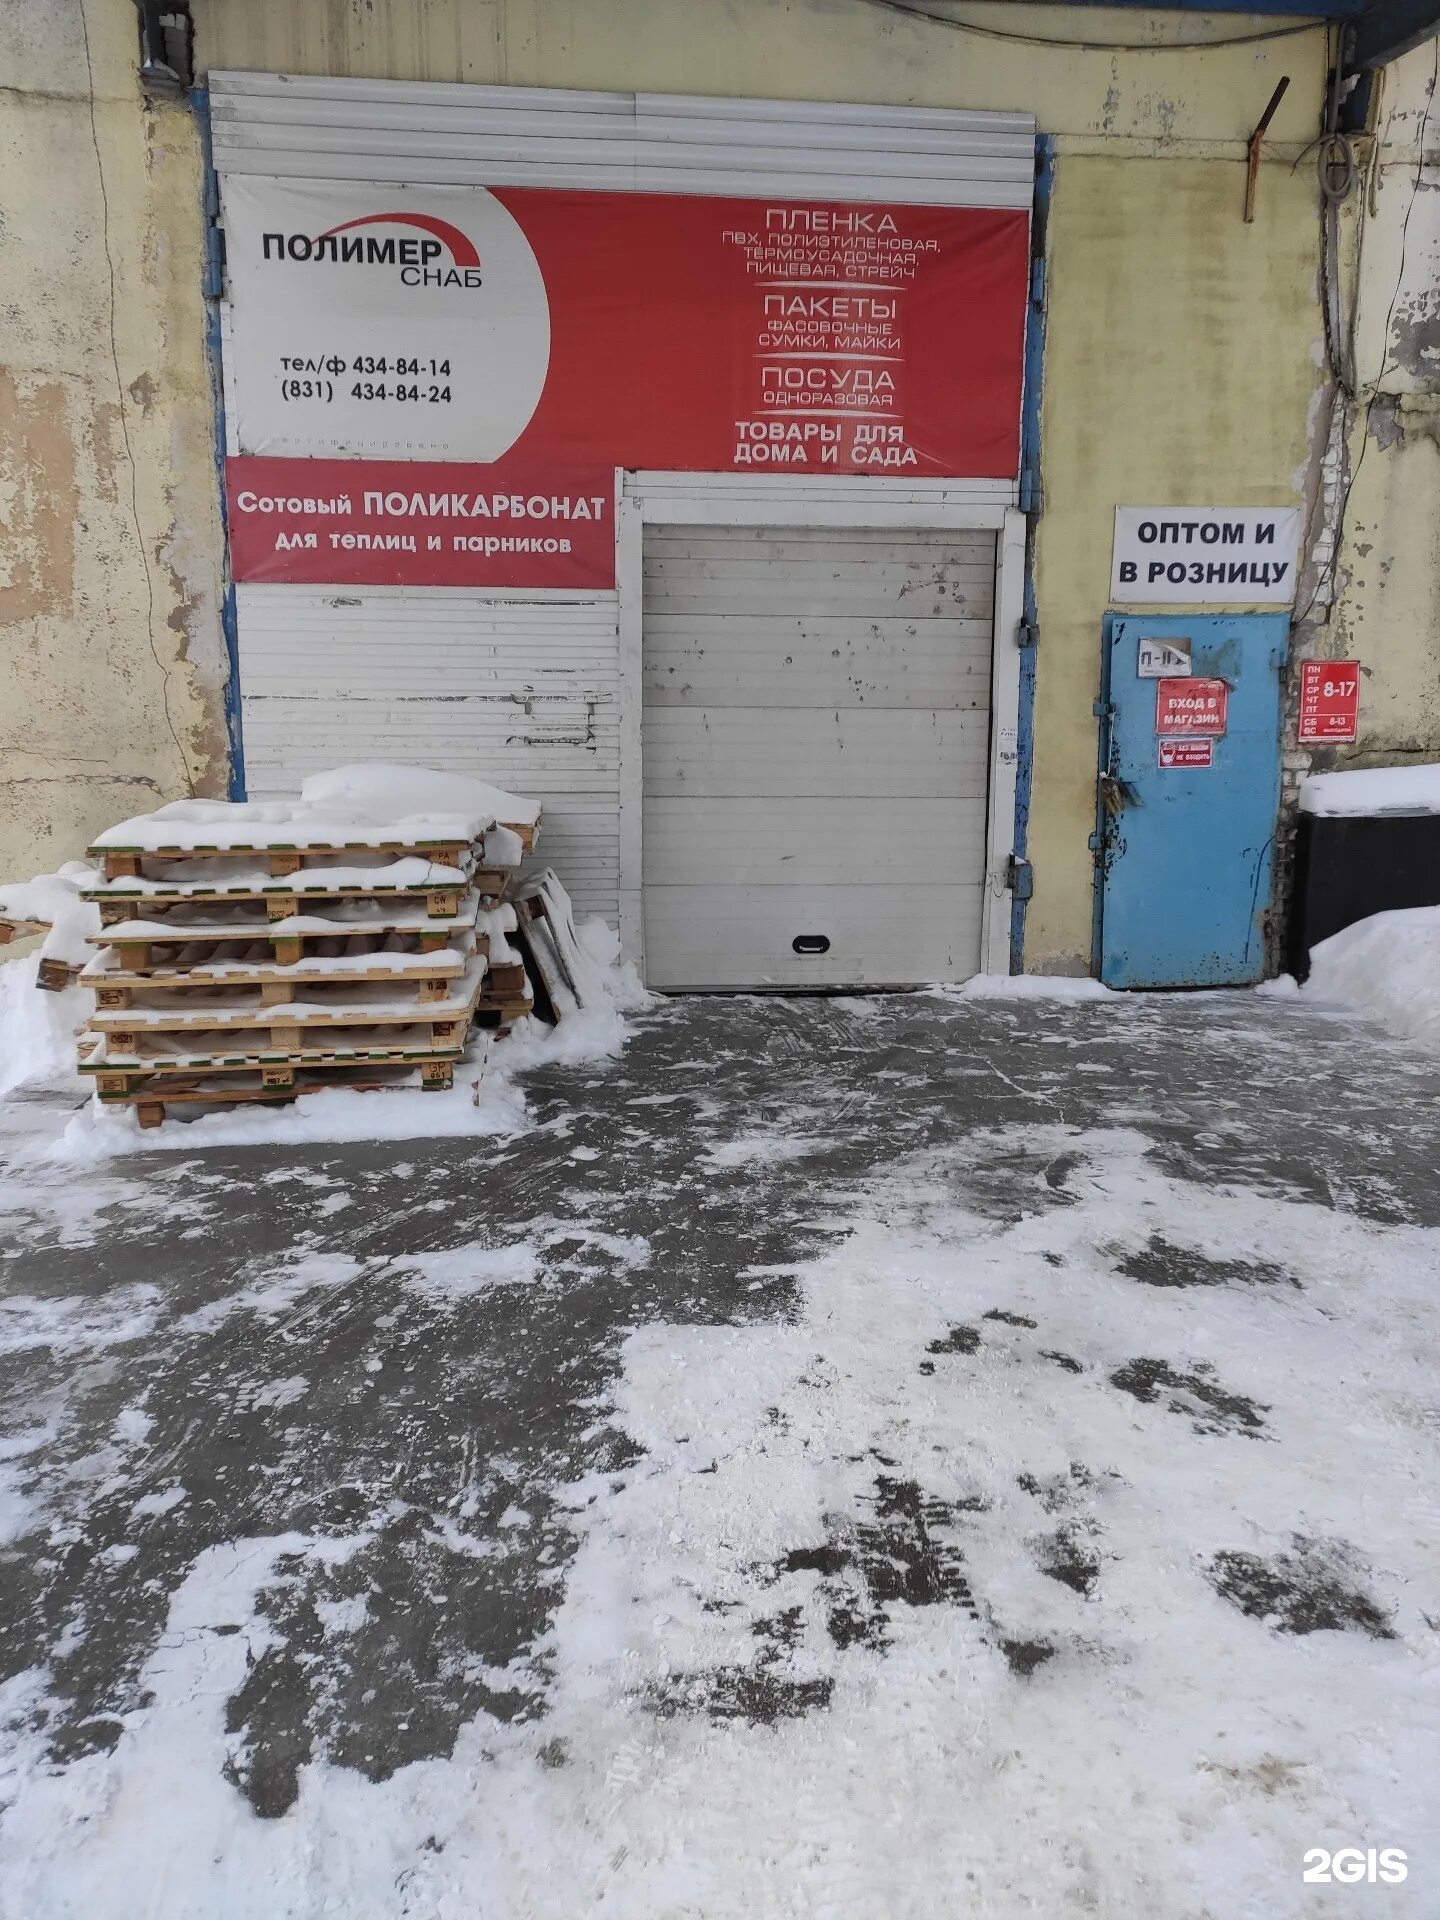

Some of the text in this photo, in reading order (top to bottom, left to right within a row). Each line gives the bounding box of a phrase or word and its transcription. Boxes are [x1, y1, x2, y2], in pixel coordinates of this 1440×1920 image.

[766, 208, 898, 233] ПЛЕНКА
[262, 233, 442, 266] ПОЛИМЕР
[722, 231, 941, 253] ПВХ, ПОЛИЭТИЛЕНОВАЯ,
[744, 246, 920, 266] ТЕРМОУСАДОЧНАЯ,
[400, 267, 483, 288] СНАБ
[746, 262, 916, 279] ПИЩЕВАЯ, СТРЕЙЧ
[764, 294, 897, 319] ПАКЕТЫ
[767, 319, 893, 335] ФАСОВОЧНЫЕ
[758, 333, 901, 349] СУМКИ, МАЙКИ
[280, 355, 452, 378] тел/ф 434-84-14
[281, 379, 452, 403] (831) 434-84-24
[761, 366, 896, 393] ПОСУДА
[763, 390, 893, 406] ОДНОРАЗОВАЯ
[735, 421, 904, 444] ТОВАРЫ ДЛЯ
[733, 442, 918, 467] ДОМА И САДА
[237, 491, 605, 520] Сотовый ПОЛИКАРБОНАТ
[1137, 521, 1276, 544] ОПТОМ И
[275, 532, 572, 557] для теплиц и парников
[1119, 561, 1289, 587] В РОЗНИЦУ
[1323, 681, 1356, 697] 8-17
[1168, 697, 1217, 710] ВХОД В
[1304, 718, 1317, 726] СБ
